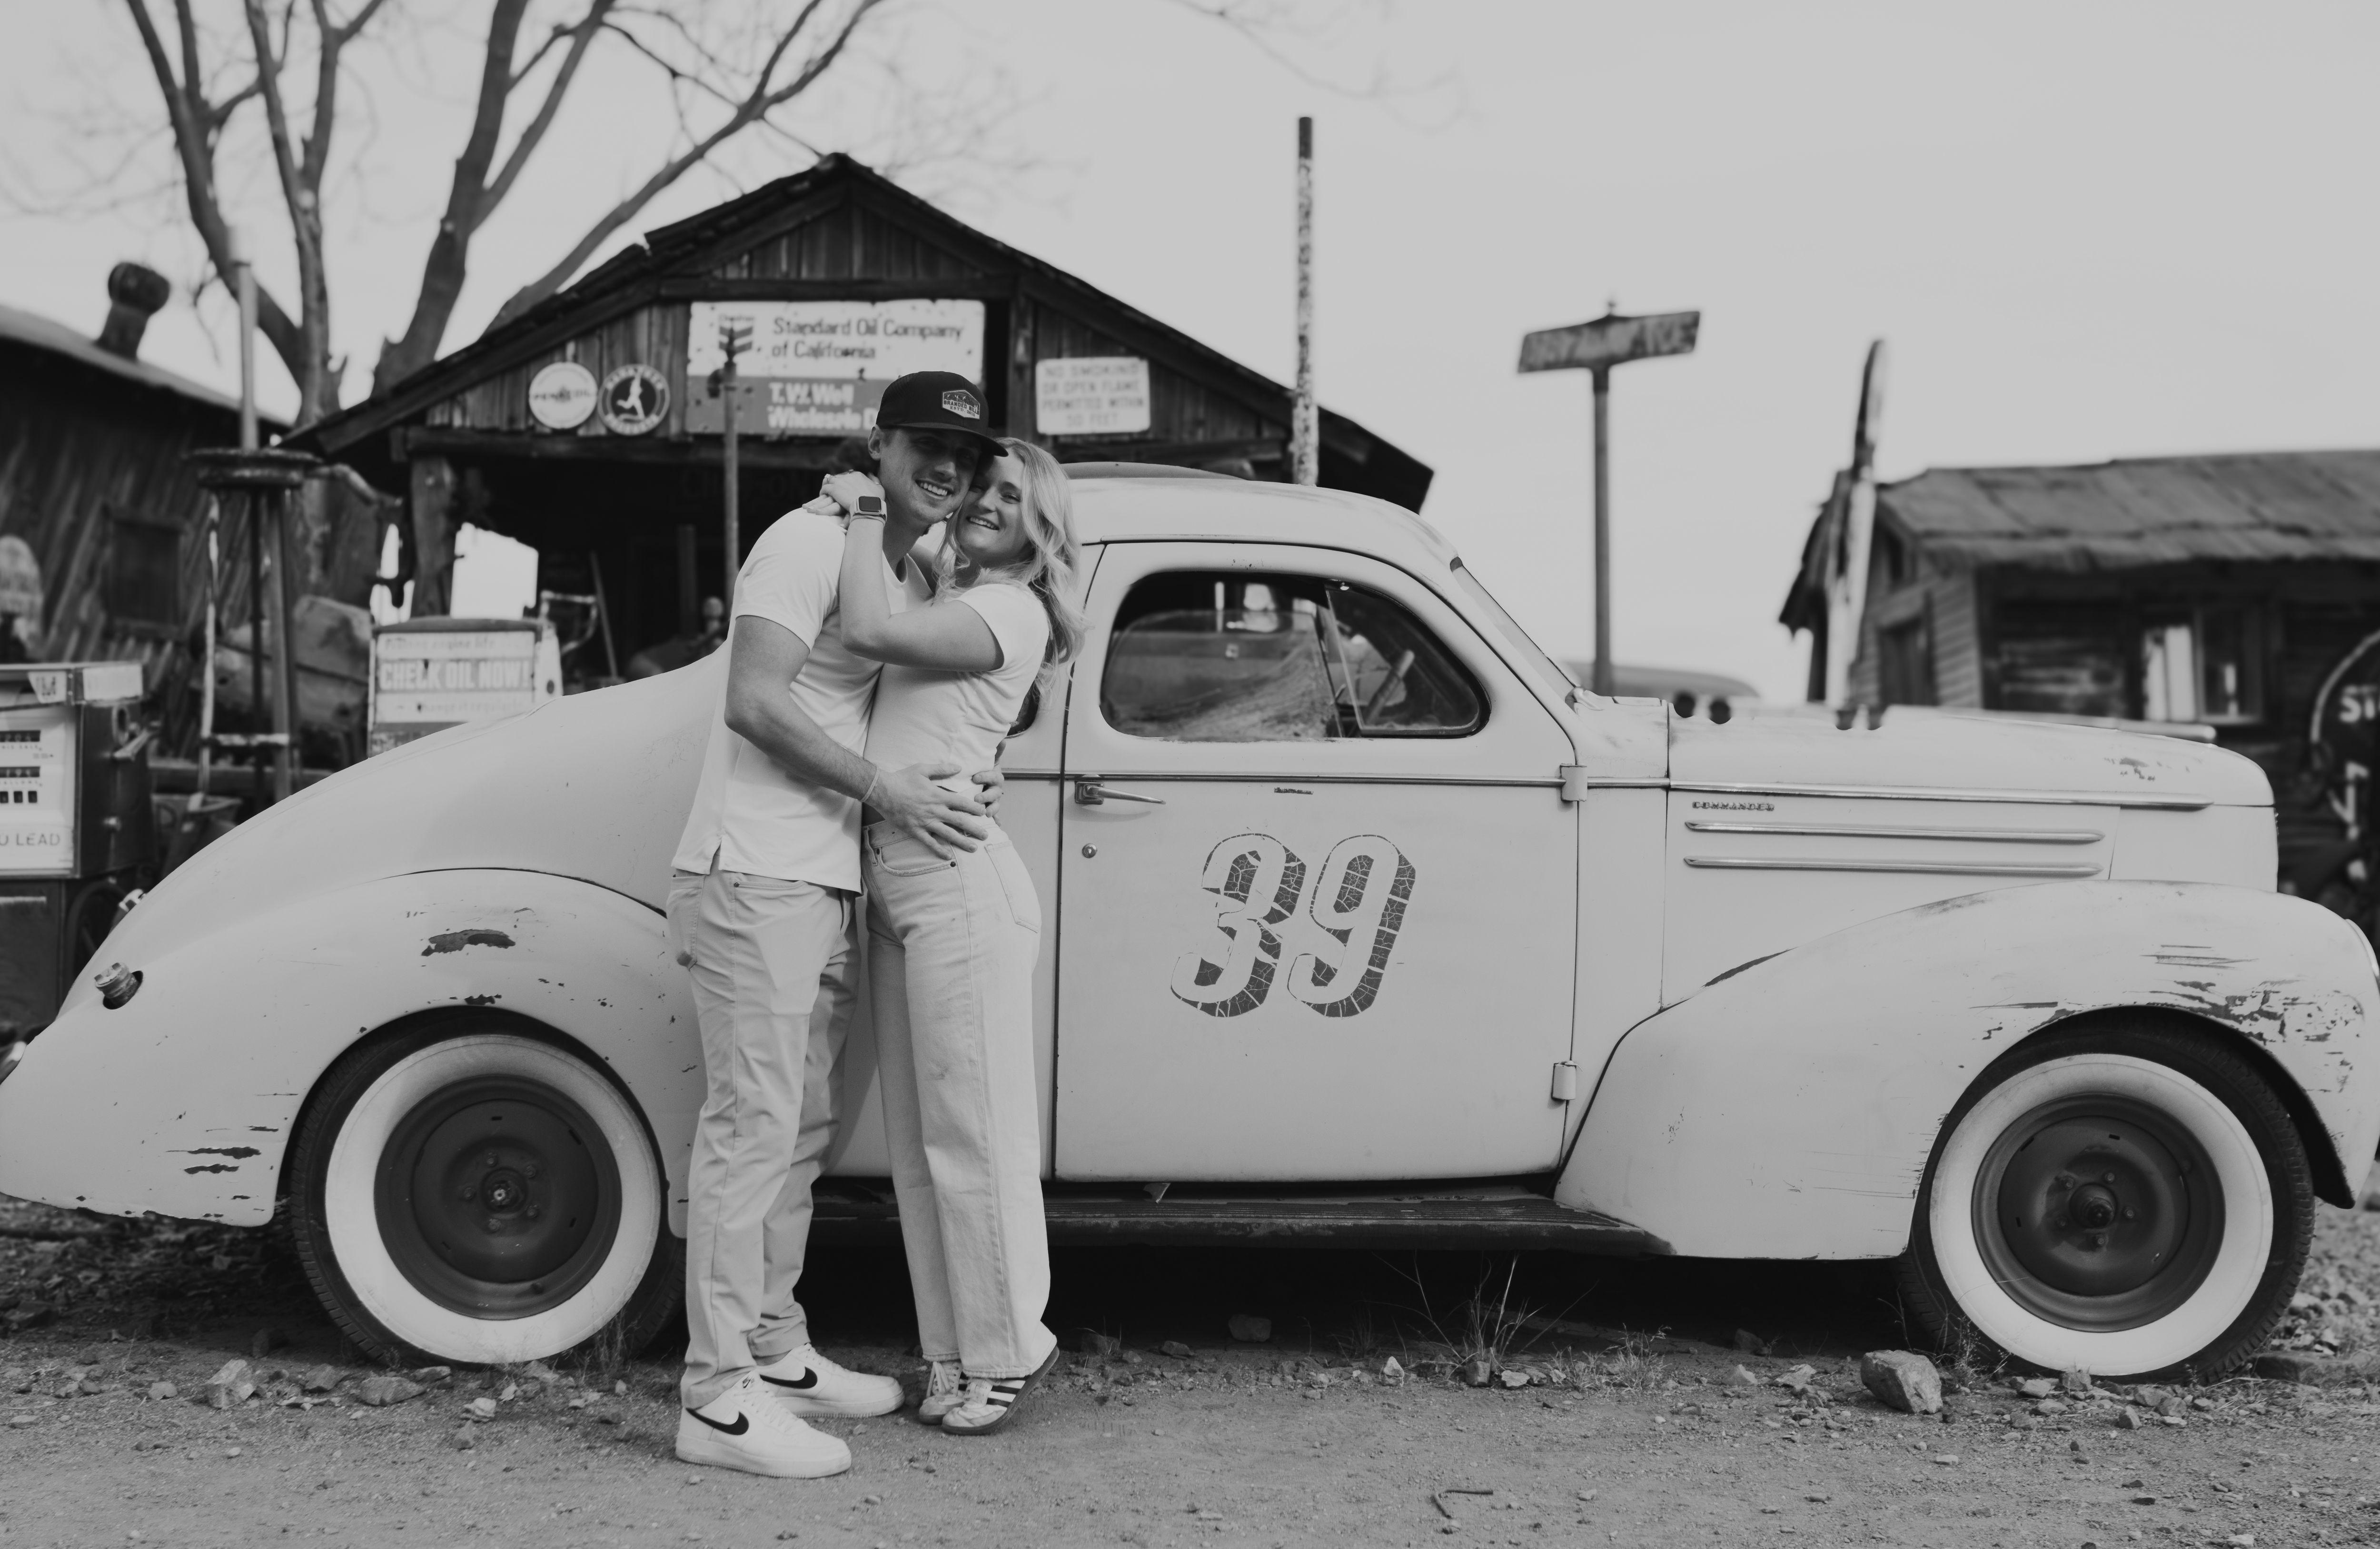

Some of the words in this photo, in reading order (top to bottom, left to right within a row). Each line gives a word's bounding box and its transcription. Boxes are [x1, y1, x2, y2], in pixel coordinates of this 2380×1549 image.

[773, 317, 851, 335] Standard
[857, 318, 878, 336] Oil
[883, 318, 964, 343] Company
[772, 340, 788, 357] of
[794, 340, 876, 360] California
[767, 406, 862, 430] Wholesale
[943, 400, 967, 409] BRANDED
[969, 405, 980, 416] BILLS
[380, 660, 441, 690] CHECK
[445, 660, 476, 689] OIL
[478, 660, 529, 689] NOW!
[1692, 801, 1775, 811] COMMANDER
[16, 833, 60, 846] LEAD
[1170, 833, 1416, 1018] 39
